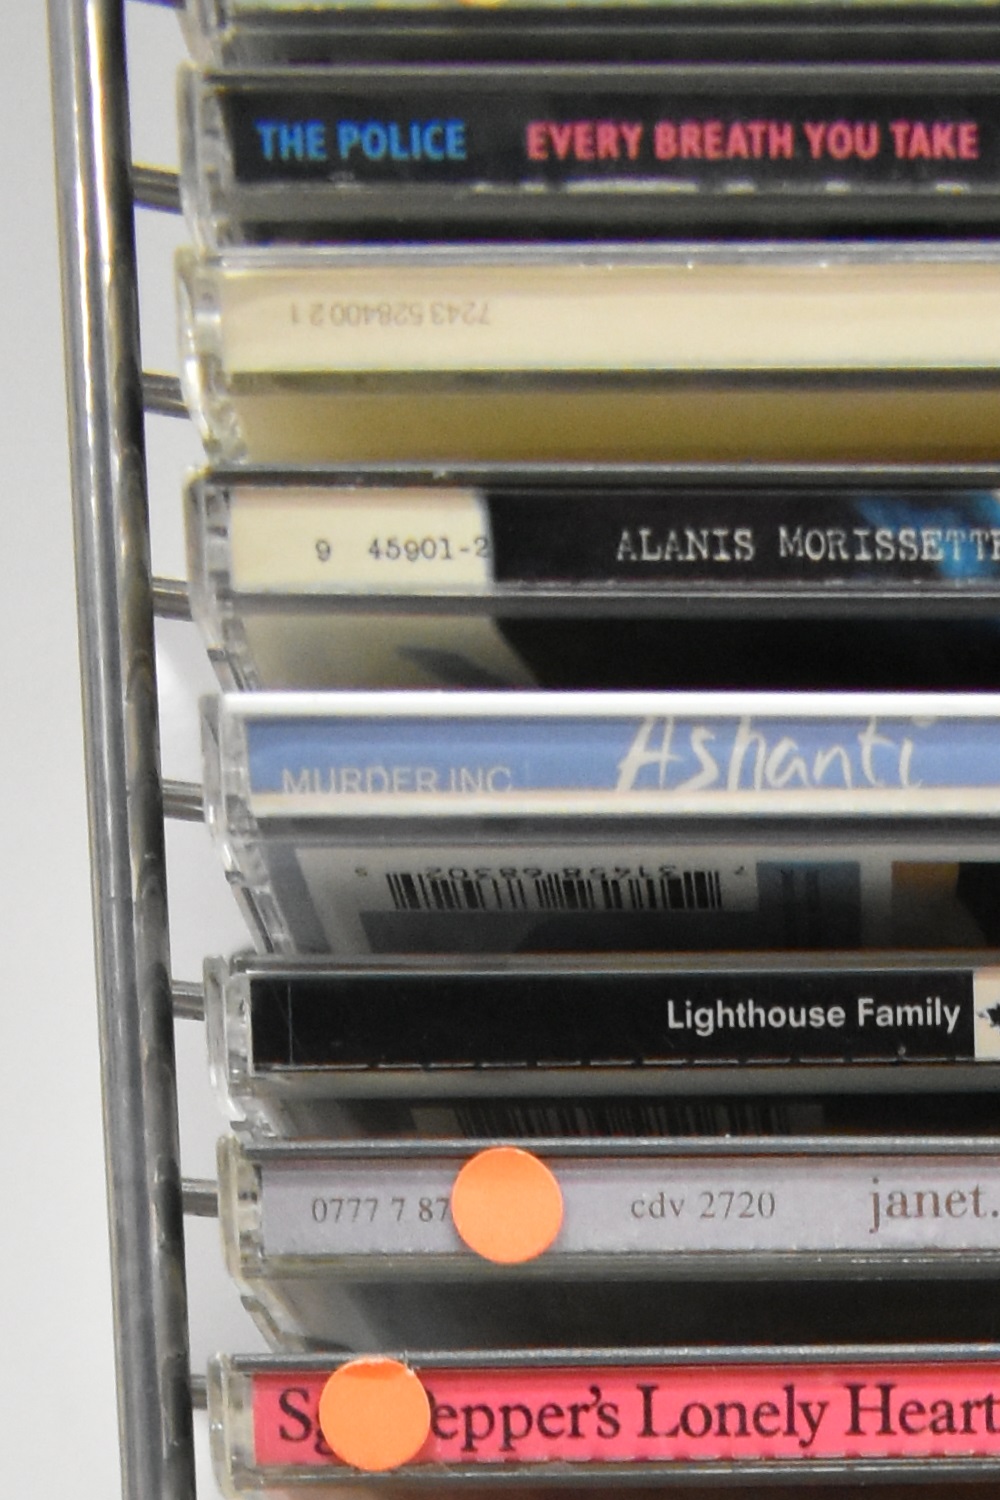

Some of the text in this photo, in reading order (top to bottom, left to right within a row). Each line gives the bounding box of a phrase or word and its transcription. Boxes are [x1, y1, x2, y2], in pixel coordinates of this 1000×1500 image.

[258, 120, 466, 161] THE POLICE
[526, 120, 978, 161] EVERY BREATH YOU TAKE
[368, 536, 490, 563] 45901-2
[617, 528, 756, 563] ALANIS
[616, 715, 937, 793] Ashanti
[667, 998, 961, 1036] Lighthouse Family
[311, 1198, 385, 1224] 0777
[630, 1190, 777, 1219] cdv 2720
[867, 1177, 1000, 1233] janet.
[637, 1380, 829, 1447] Lonely
